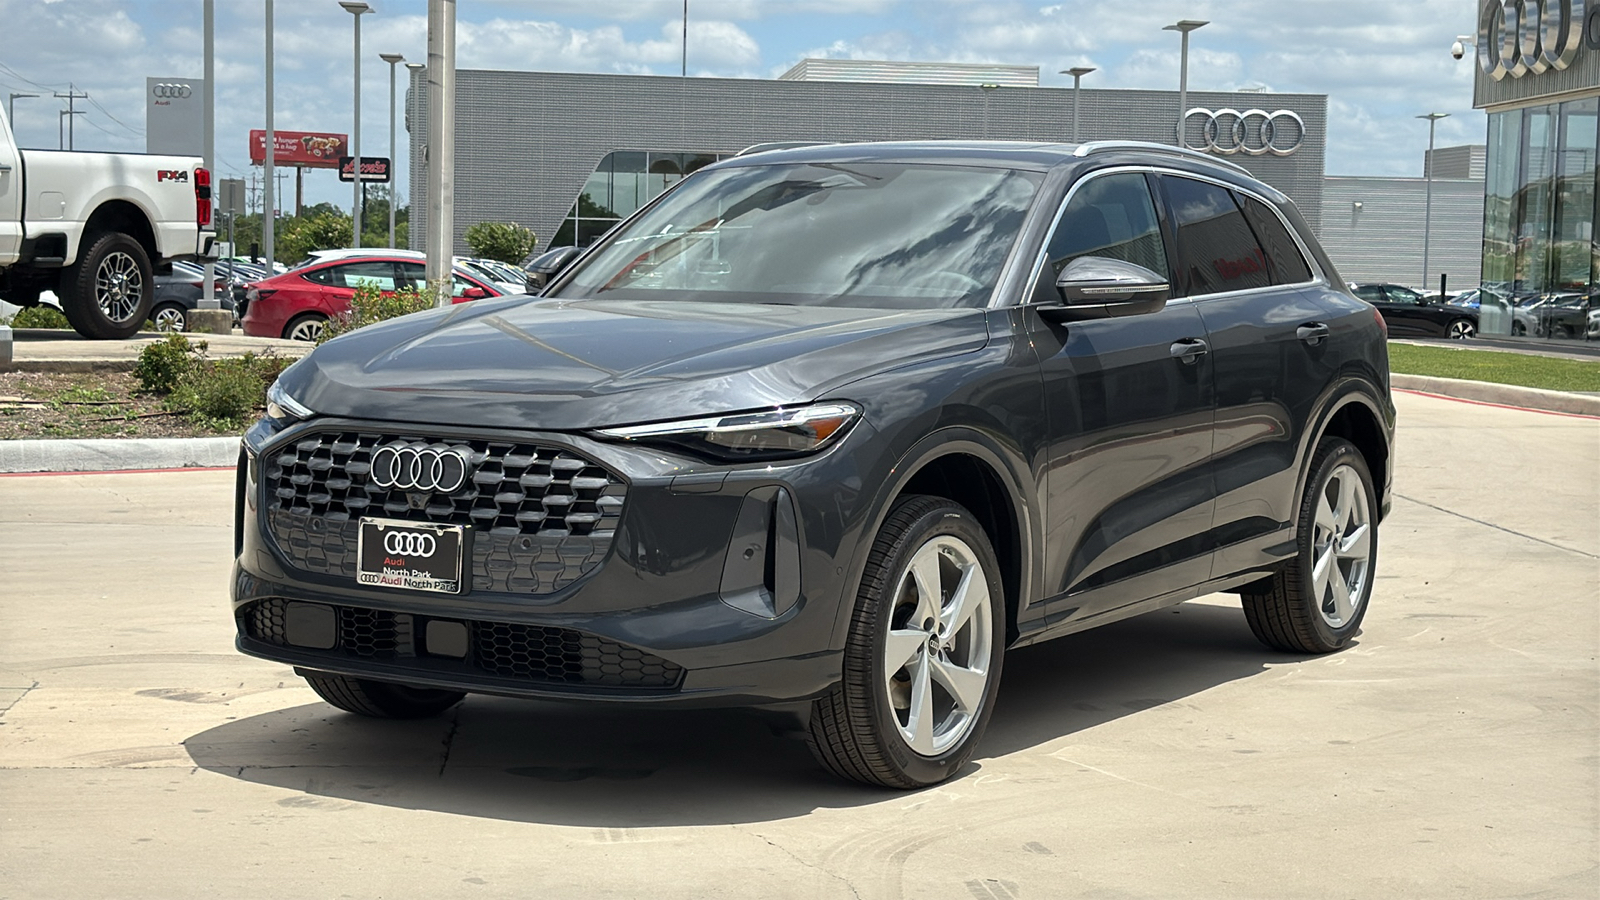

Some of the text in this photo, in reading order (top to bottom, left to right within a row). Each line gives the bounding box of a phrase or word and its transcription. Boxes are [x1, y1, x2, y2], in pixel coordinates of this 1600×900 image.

[158, 170, 188, 182] FX4
[384, 557, 405, 566] Audi
[383, 566, 432, 578] North Park
[380, 576, 456, 592] Audi North Park
